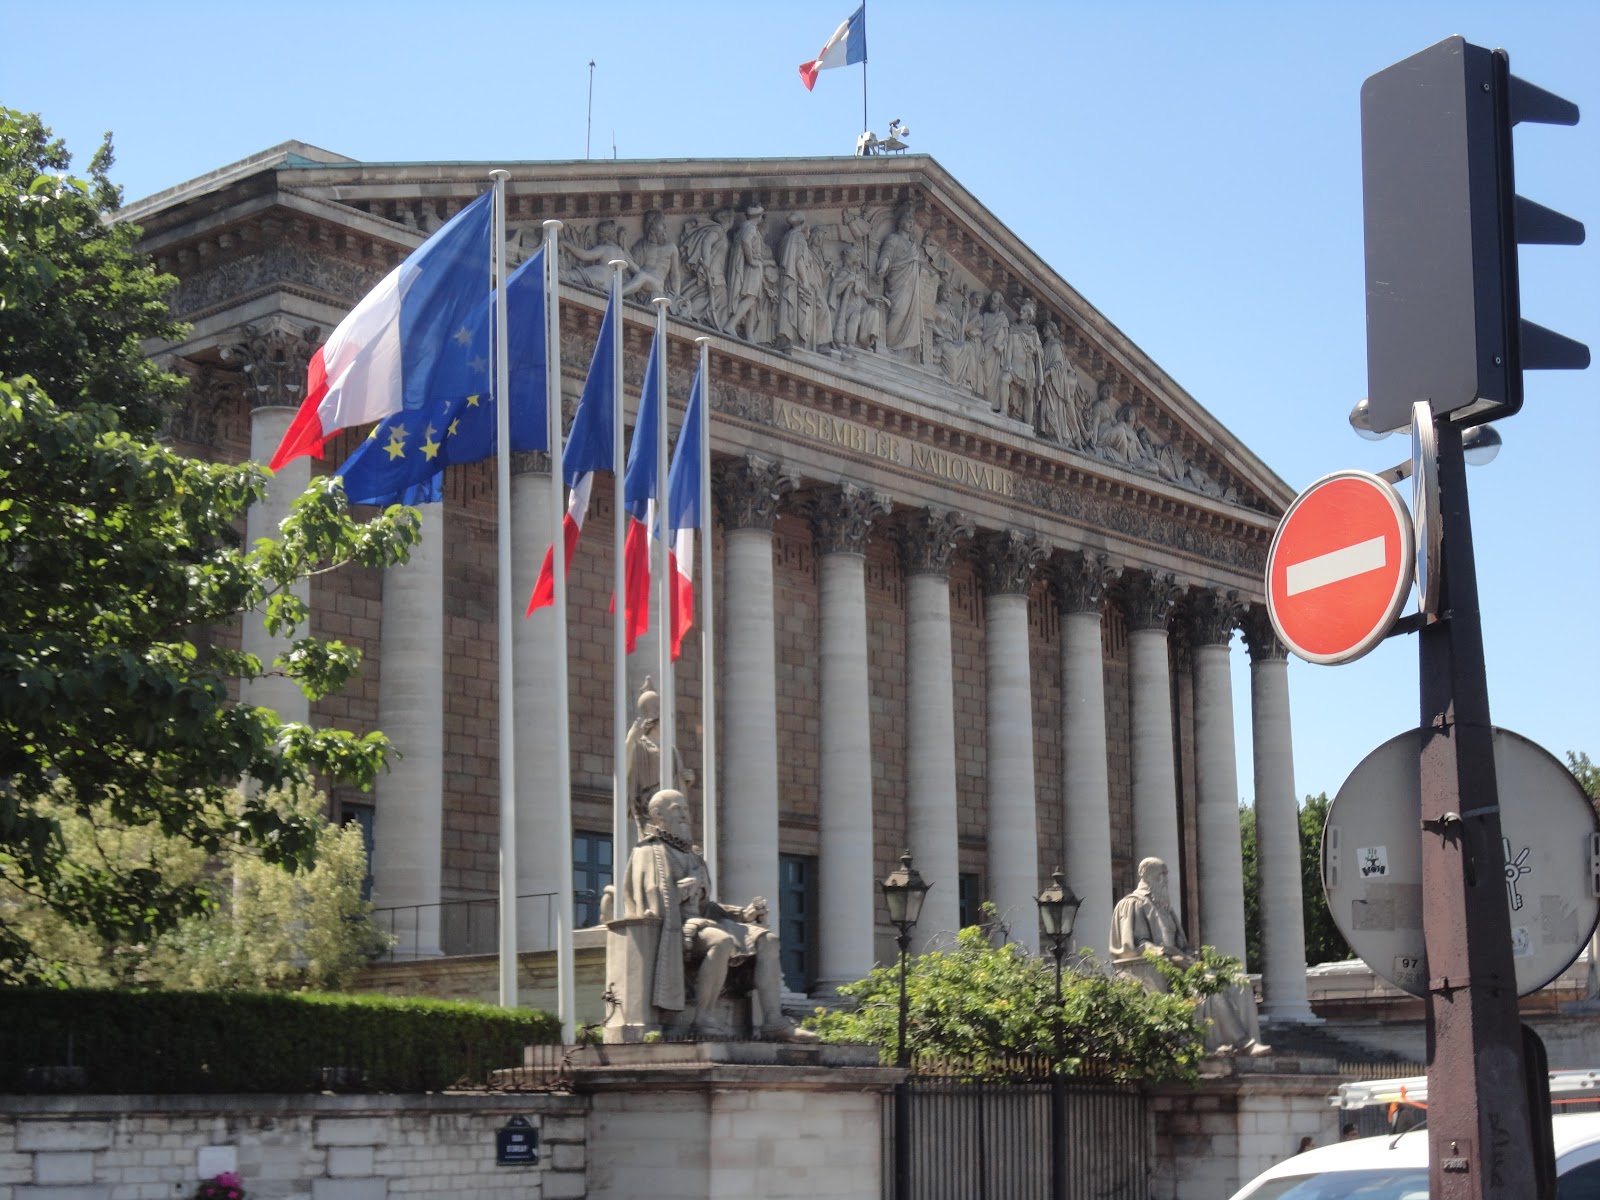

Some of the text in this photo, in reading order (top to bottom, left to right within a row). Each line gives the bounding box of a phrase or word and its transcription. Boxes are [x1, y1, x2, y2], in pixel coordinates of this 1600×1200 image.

[776, 403, 1013, 497] ASSEMBLEE NATIONALE
[1402, 958, 1418, 969] 97
